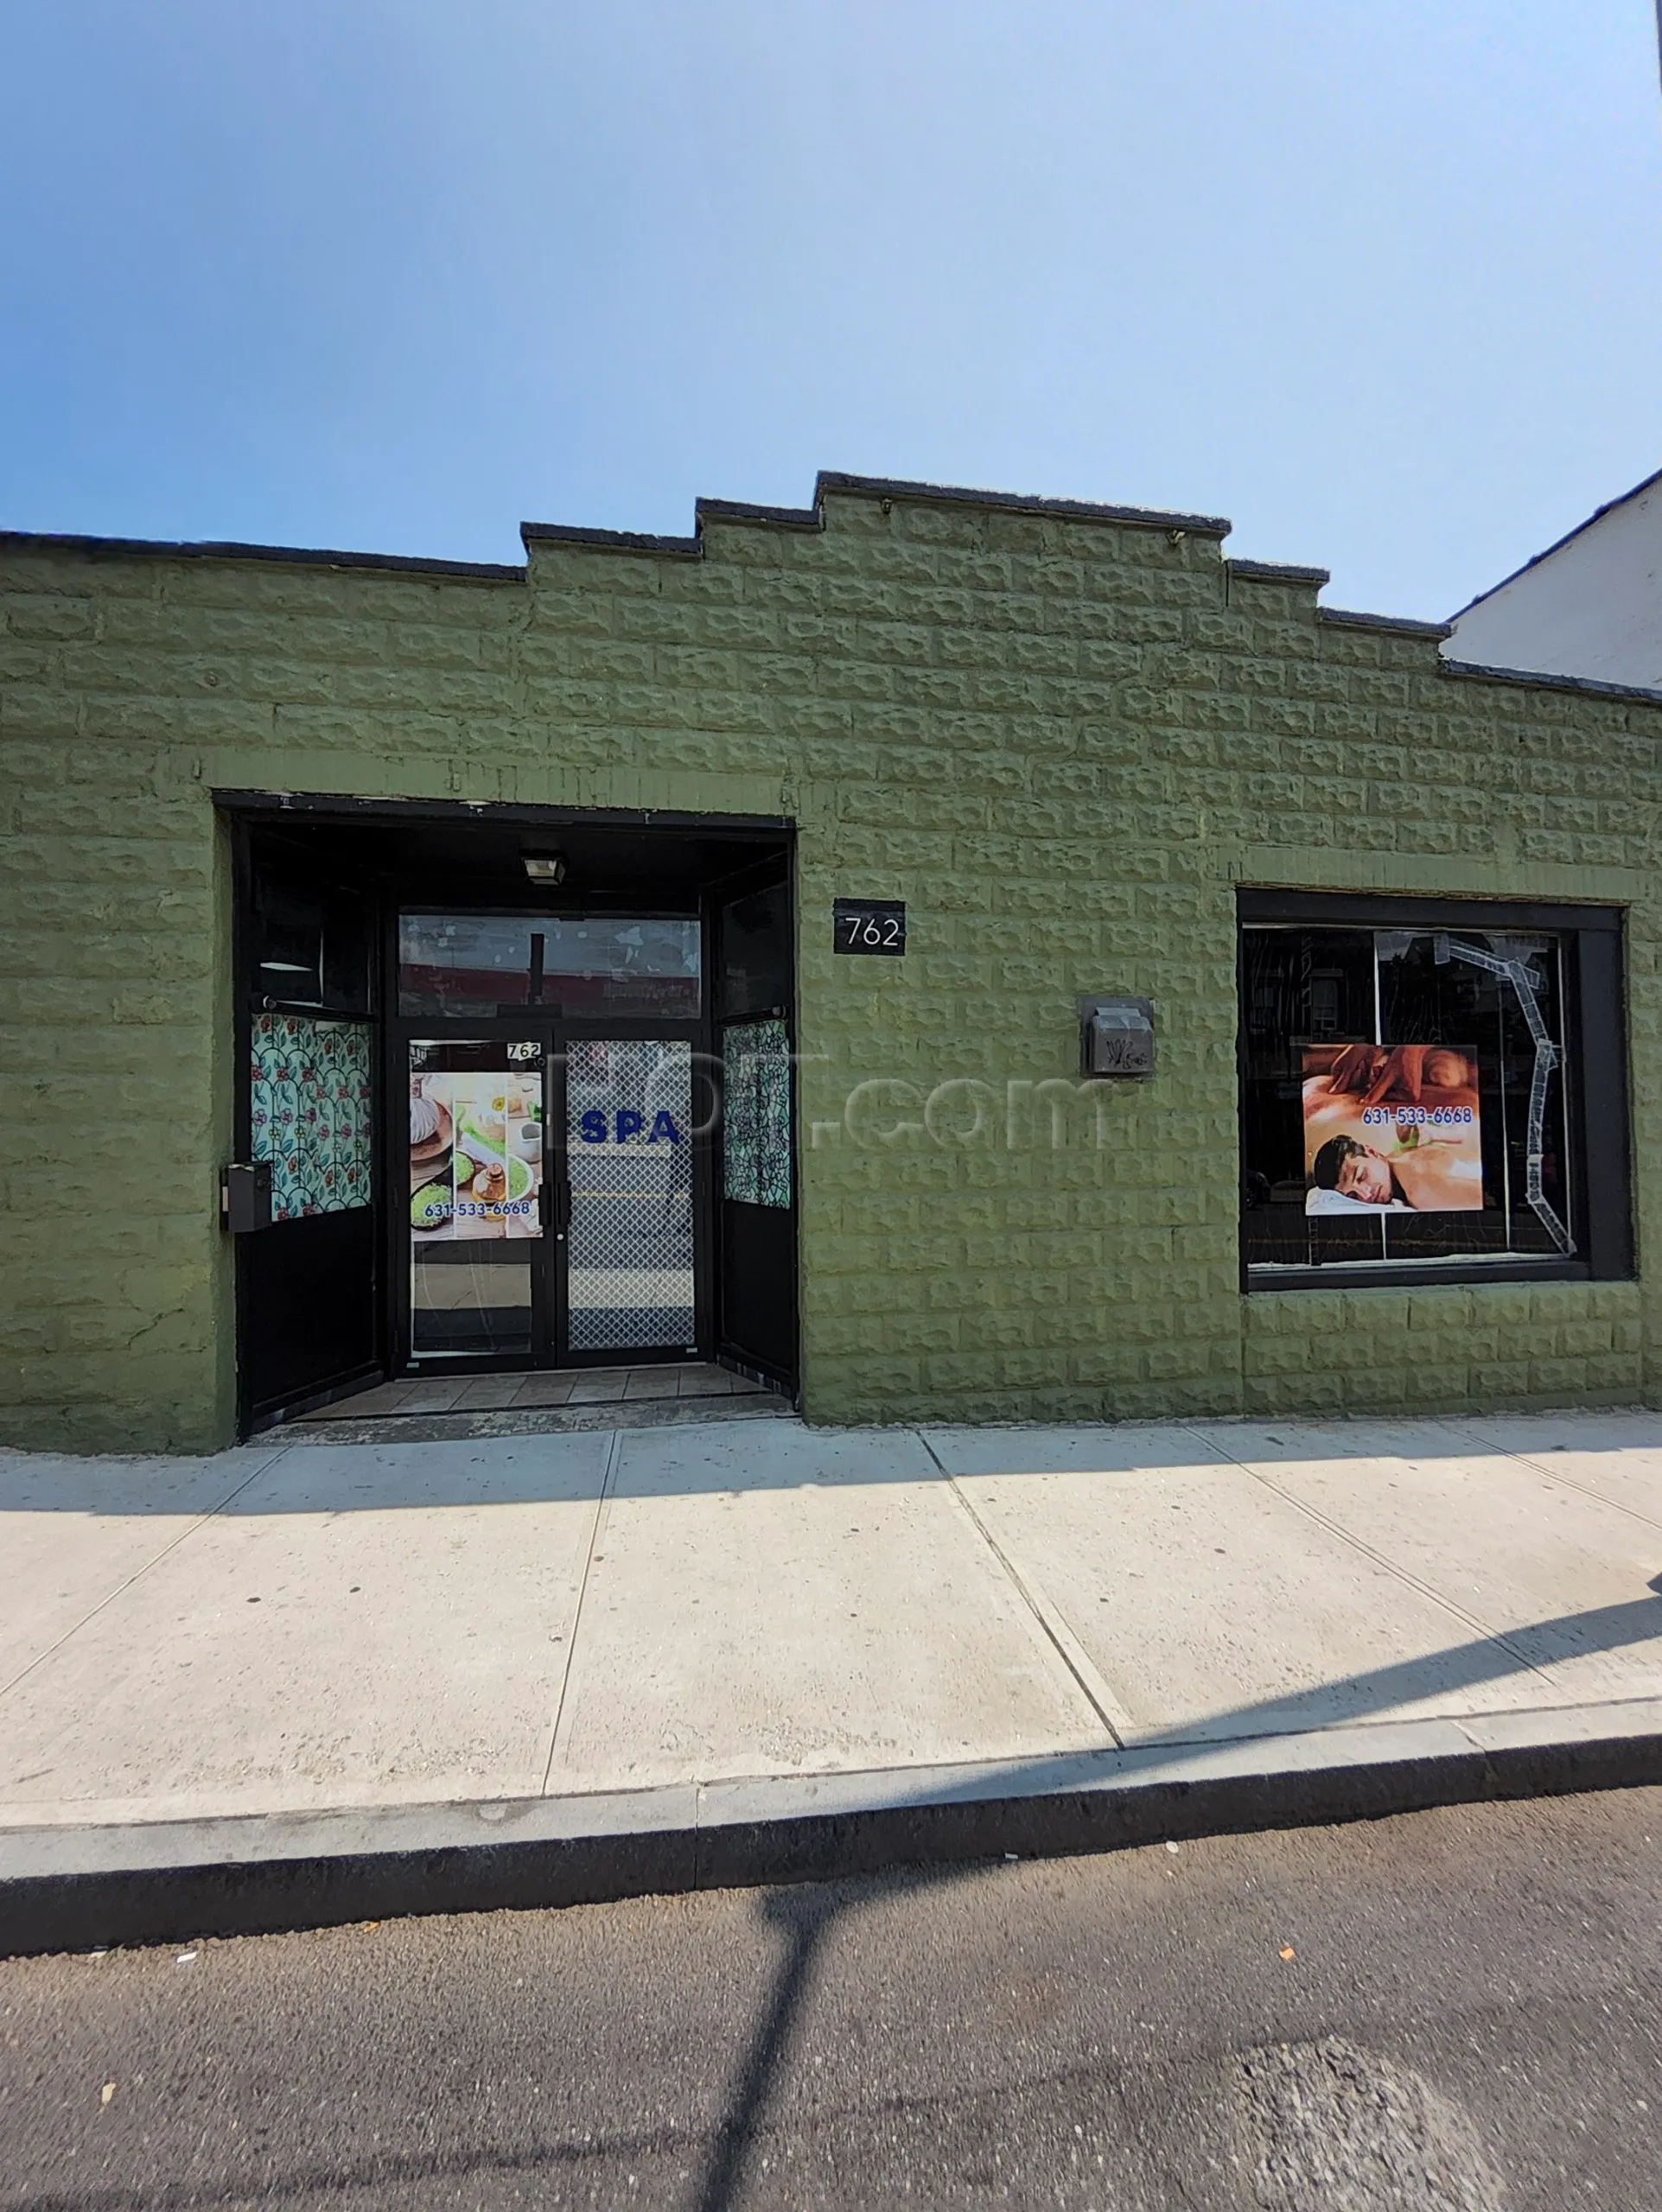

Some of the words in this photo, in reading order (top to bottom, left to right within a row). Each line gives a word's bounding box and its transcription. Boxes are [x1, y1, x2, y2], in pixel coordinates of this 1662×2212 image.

[845, 918, 899, 946] 762
[509, 1044, 539, 1058] 762
[1363, 1107, 1472, 1124] 631-533-6668
[580, 1109, 679, 1145] SPA
[424, 1201, 530, 1217] 631-533-6668
